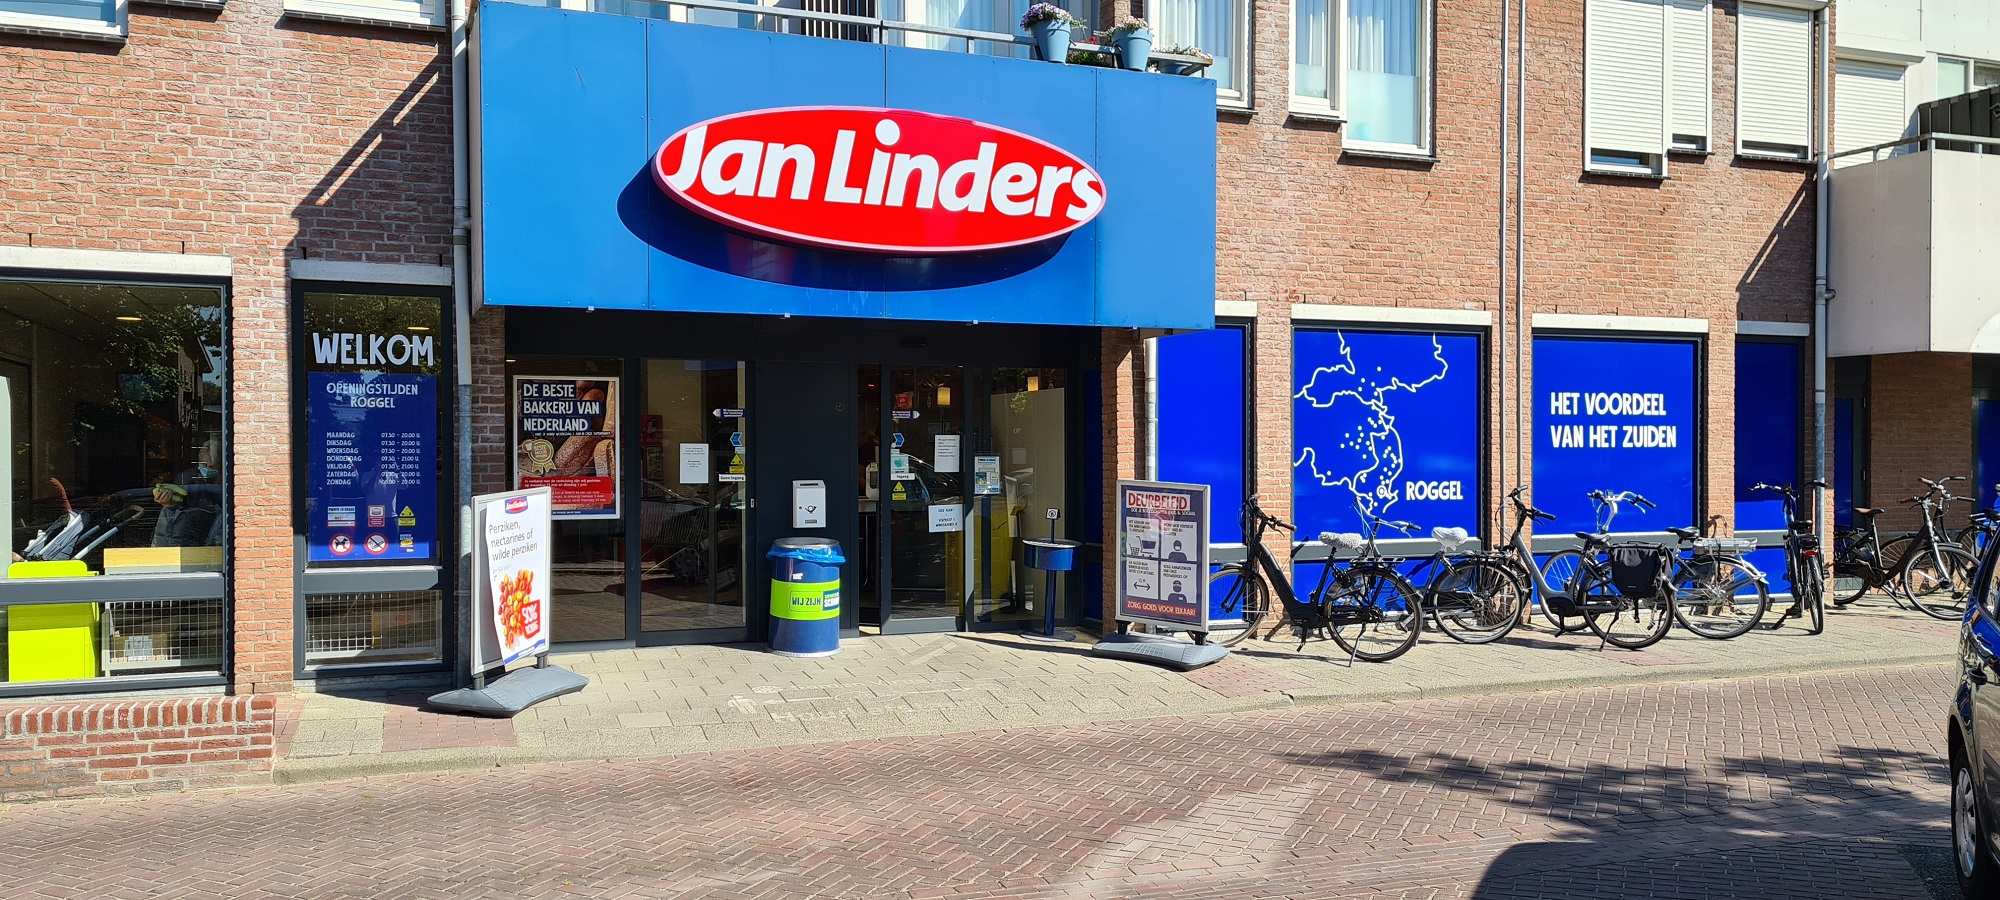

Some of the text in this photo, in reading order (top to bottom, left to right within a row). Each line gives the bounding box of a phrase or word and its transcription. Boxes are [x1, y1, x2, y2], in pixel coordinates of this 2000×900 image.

[665, 118, 1104, 221] Jan Linders
[312, 333, 434, 366] WELKOM
[326, 382, 418, 395] OPENINGSTIJDEN
[523, 384, 575, 398] DE BESTE
[350, 396, 396, 408] ROGGEL
[523, 401, 600, 414] BAKKERIJ VAN
[1550, 392, 1667, 416] HET VOORDEEL
[523, 418, 589, 431] NEDERLAND
[1550, 425, 1677, 448] VAN HET ZUIDEN
[1406, 480, 1463, 500] ROGGEL
[1128, 492, 1188, 510] DEURBELEID
[489, 521, 520, 535] Perziken,
[491, 528, 534, 548] nectarines of
[492, 542, 538, 561] wilde perziken
[792, 597, 804, 605] WIJ
[806, 597, 821, 606] ZIJN
[1127, 600, 1196, 615] ZORG GOED VOOR ELKAAR!
[522, 603, 538, 624] 50%
